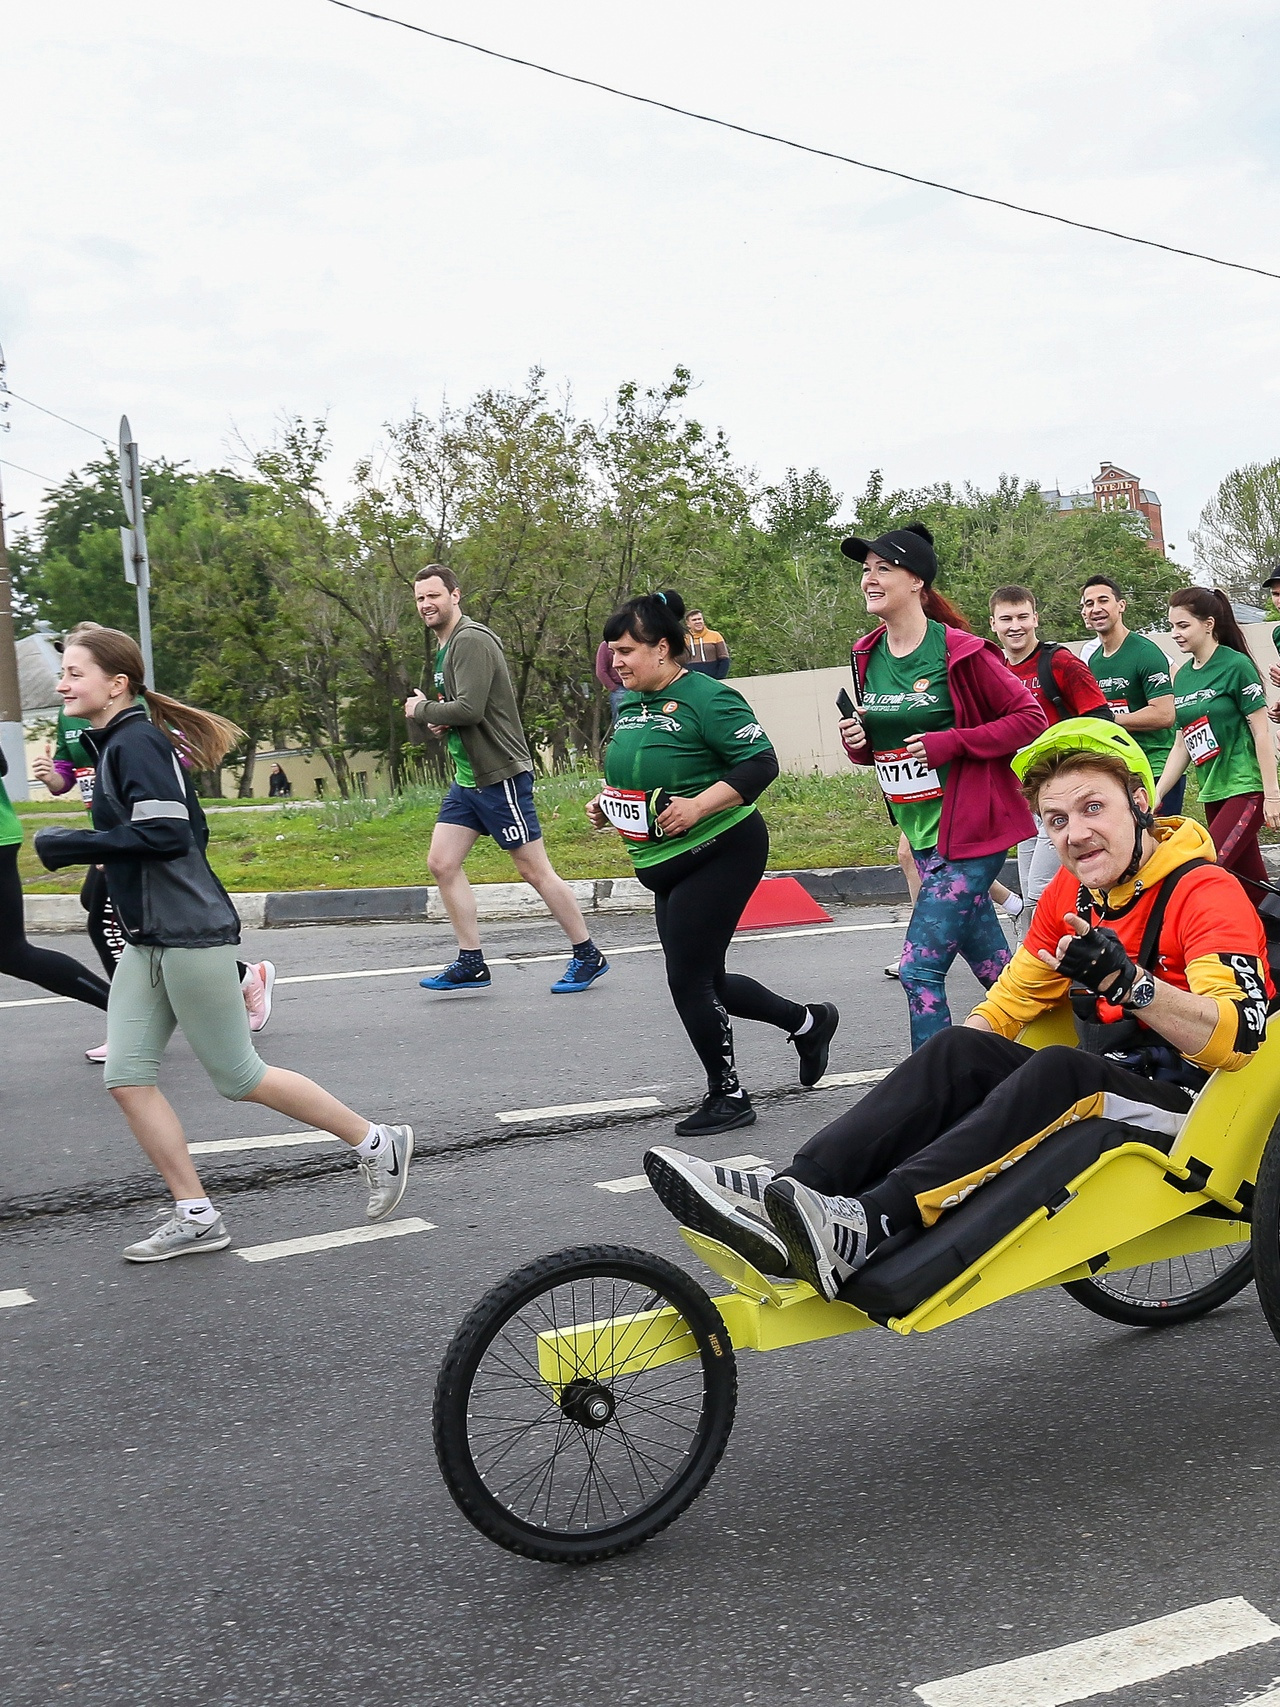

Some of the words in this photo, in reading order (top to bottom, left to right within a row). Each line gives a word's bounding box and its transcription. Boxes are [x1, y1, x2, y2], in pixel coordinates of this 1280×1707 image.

[1095, 481, 1133, 493] ОТЕЛЬ
[876, 761, 928, 782] 11712
[603, 799, 640, 821] 11705
[502, 825, 520, 842] 10
[708, 1333, 723, 1357] HERO
